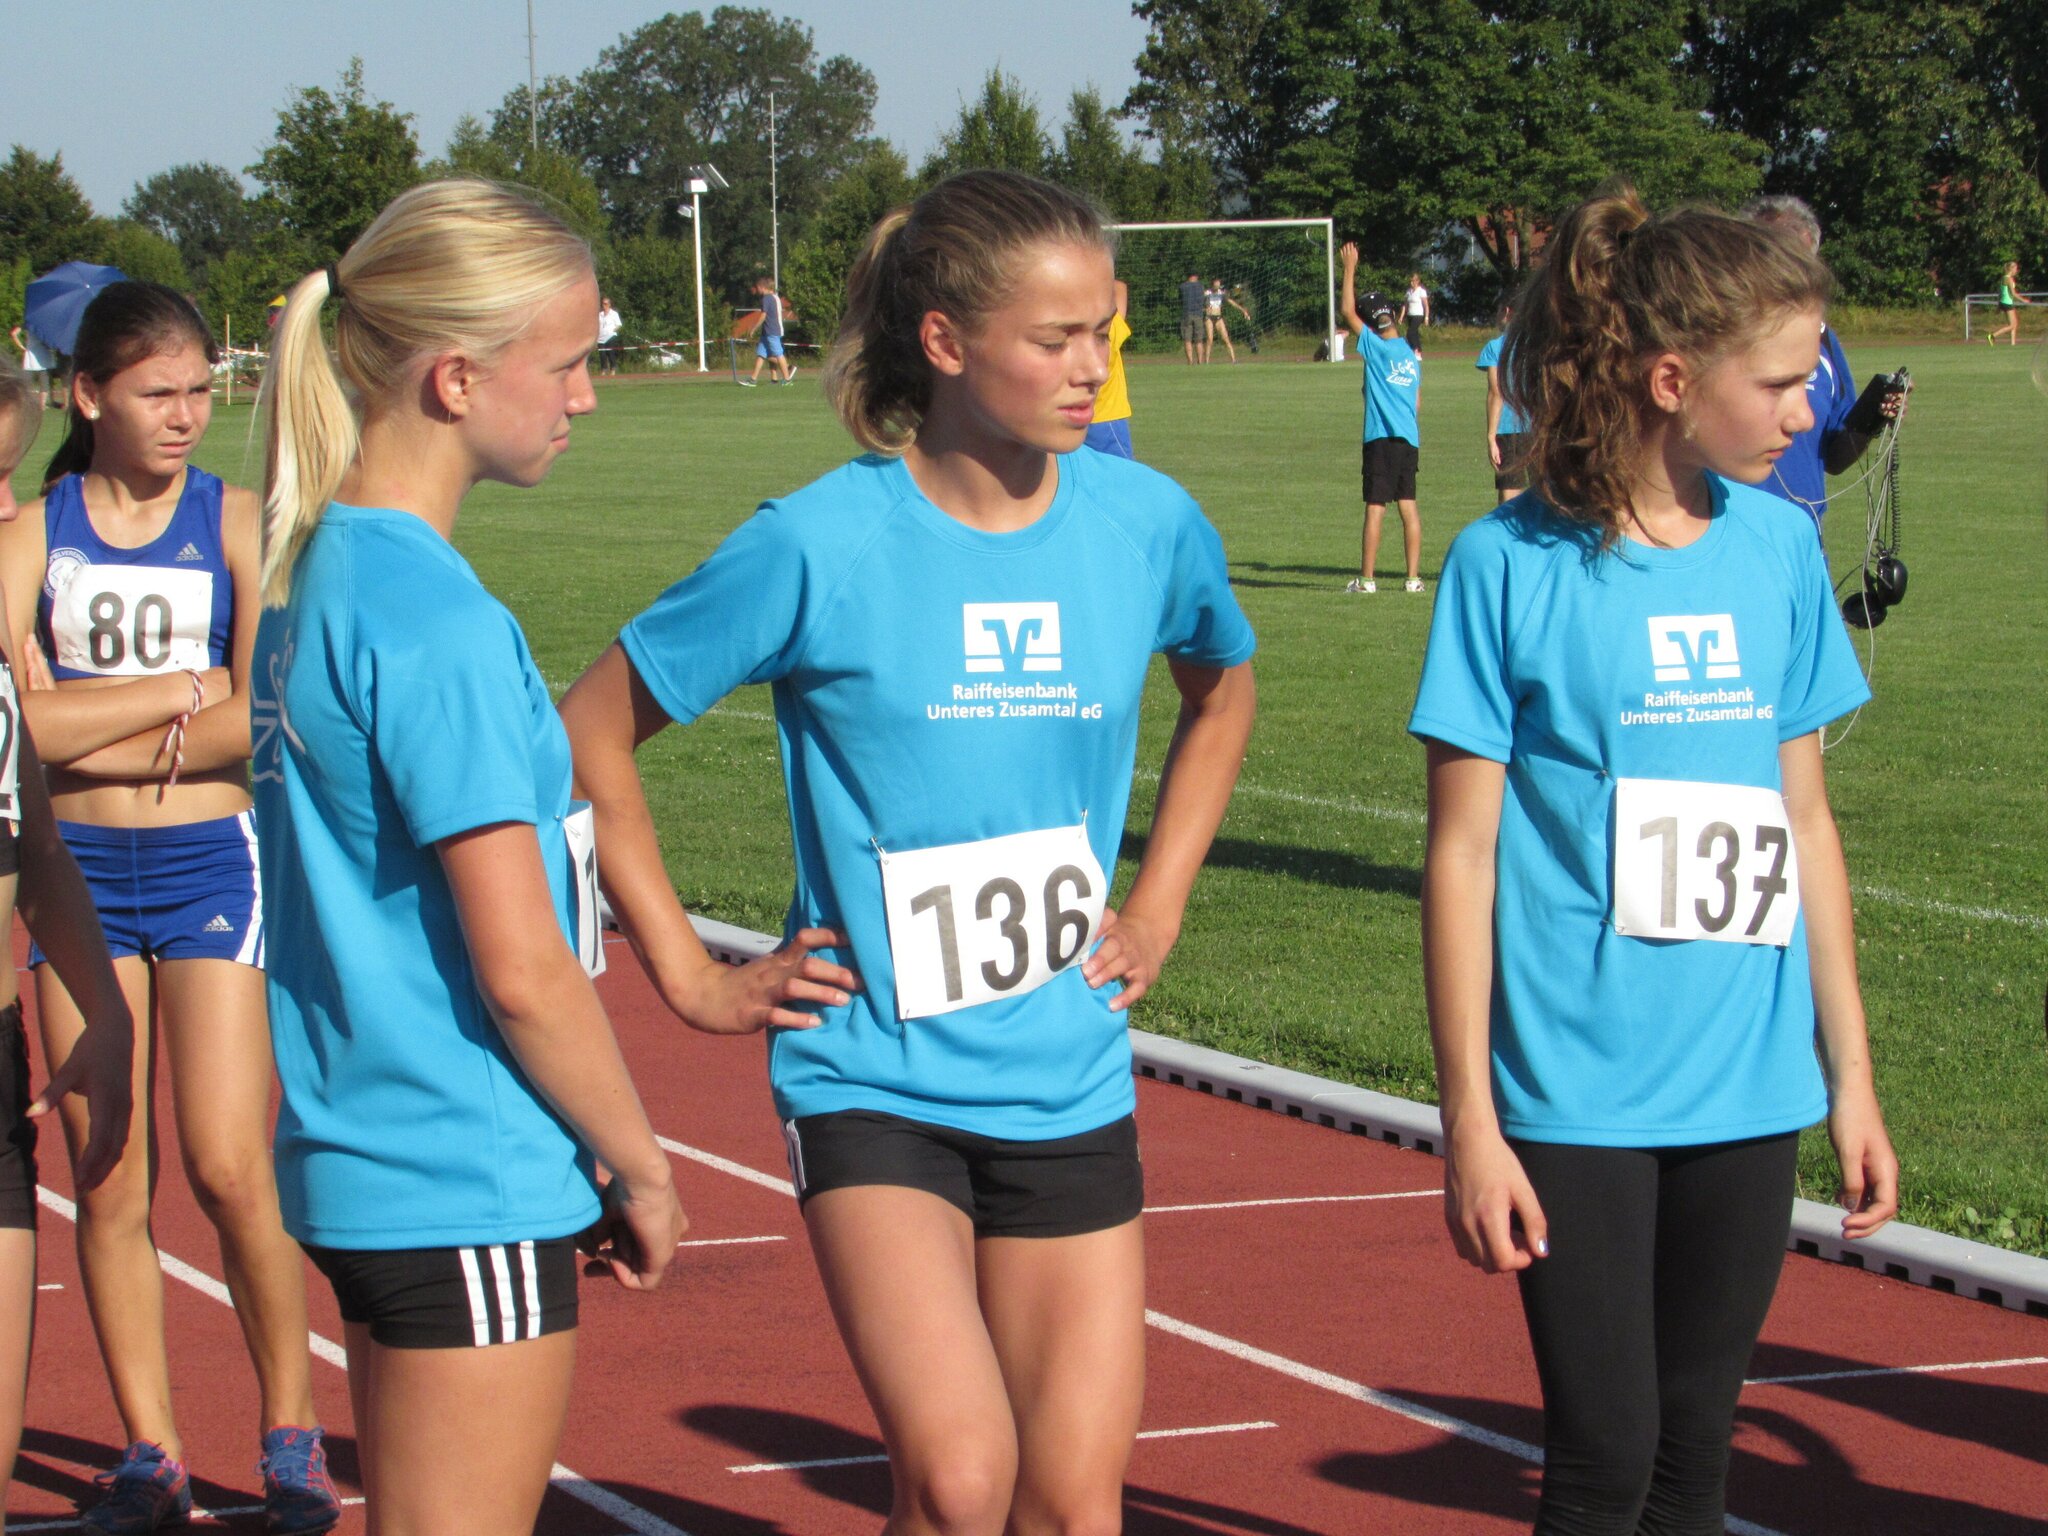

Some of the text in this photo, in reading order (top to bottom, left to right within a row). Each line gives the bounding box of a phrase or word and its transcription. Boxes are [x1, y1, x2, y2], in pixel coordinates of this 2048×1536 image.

[176, 554, 204, 562] adidas
[89, 591, 173, 669] 80
[953, 682, 1078, 700] Raiffeisenbank
[1644, 686, 1755, 708] Raiffeisenbank
[927, 701, 1103, 720] Unteres Zusamtal eG
[1620, 703, 1774, 726] Unteres Zusamtal eG
[1639, 816, 1789, 937] 137
[910, 864, 1092, 1003] 136
